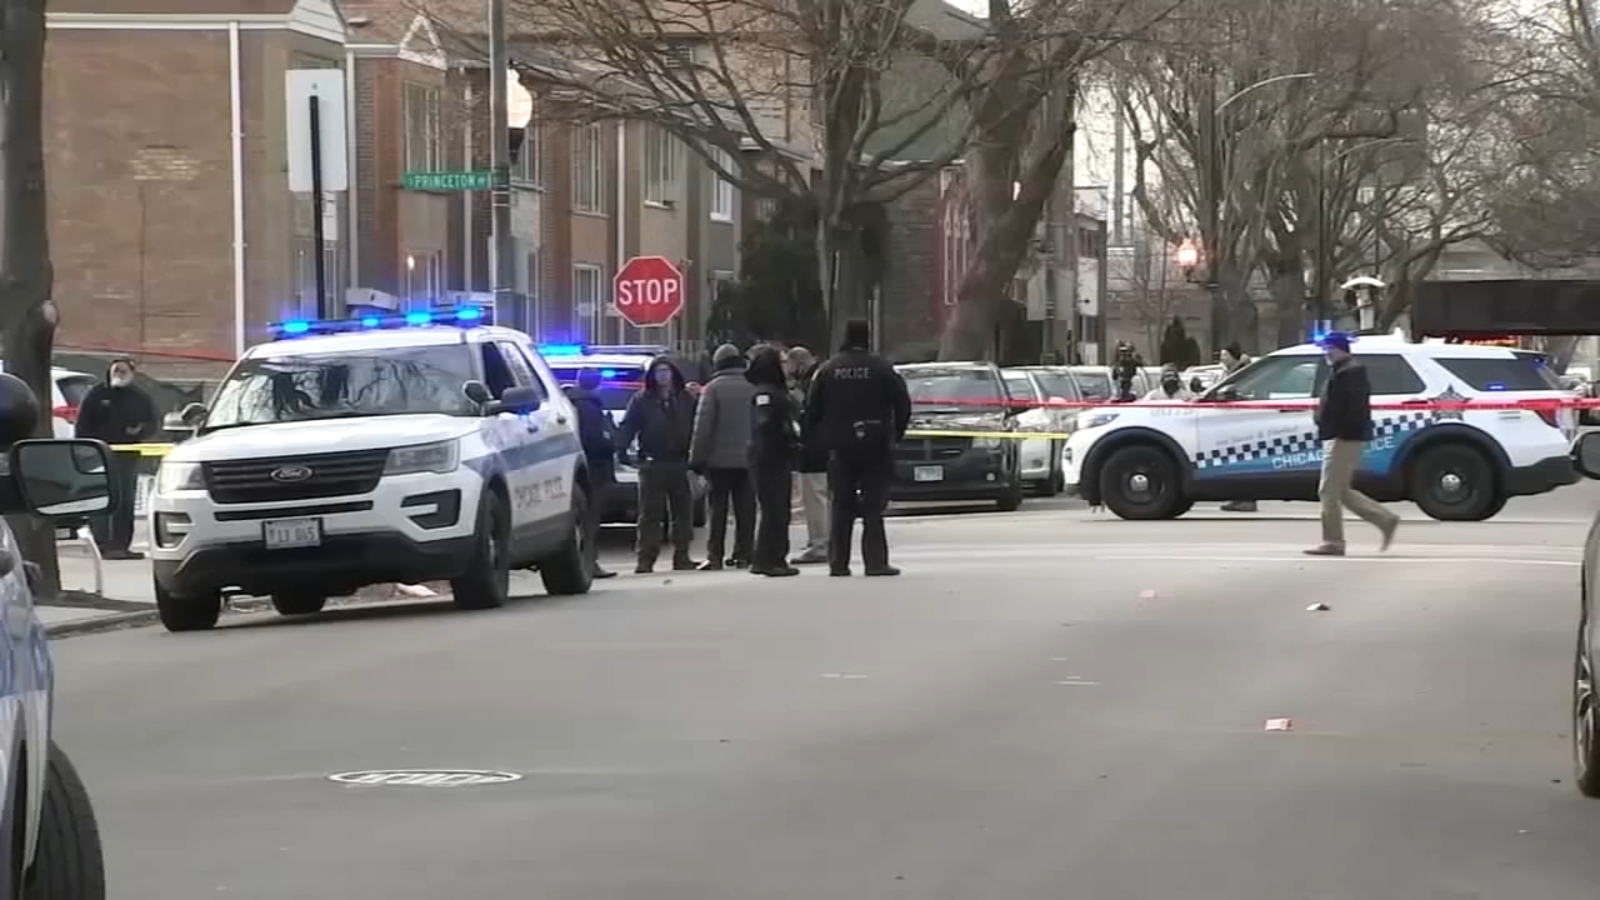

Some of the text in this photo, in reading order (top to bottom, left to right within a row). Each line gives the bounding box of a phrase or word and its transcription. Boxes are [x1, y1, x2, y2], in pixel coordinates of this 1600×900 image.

[414, 174, 476, 188] PRINCETON
[619, 279, 678, 305] STOP
[834, 367, 870, 379] POLICE
[1271, 449, 1326, 469] CHICAG
